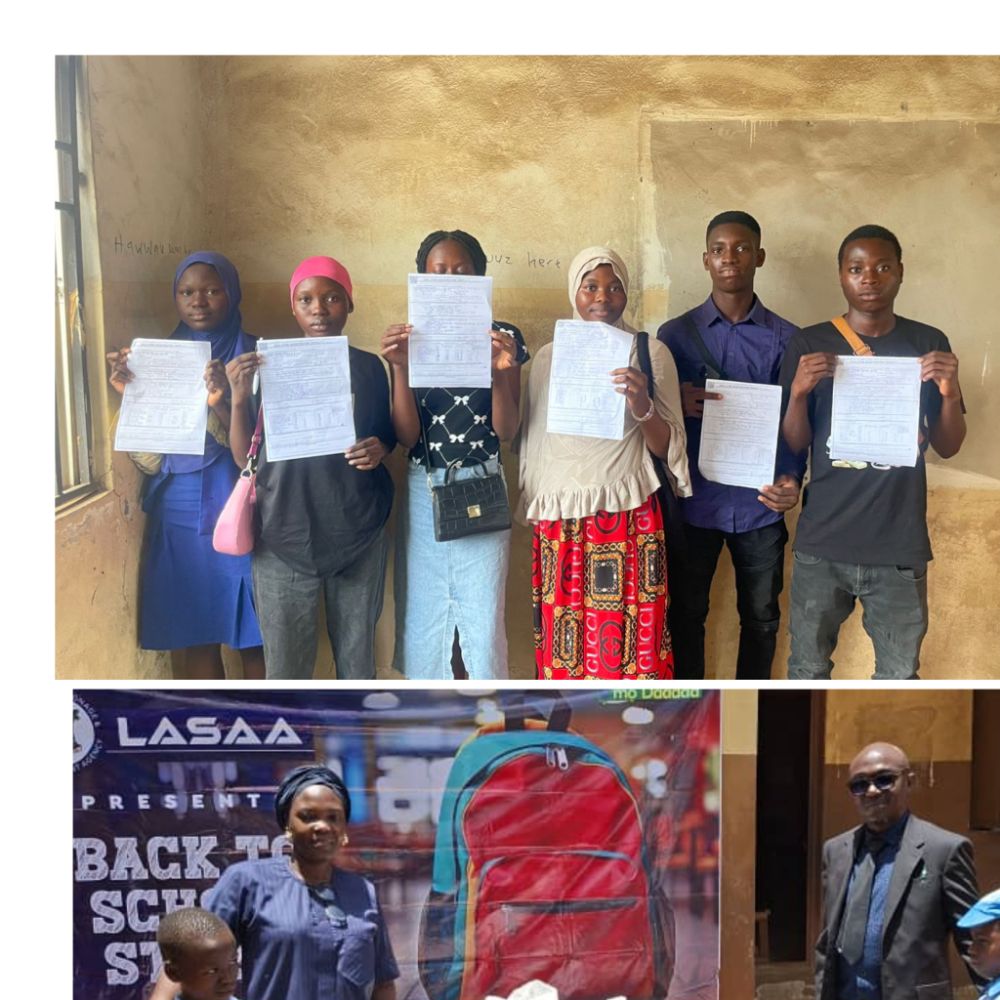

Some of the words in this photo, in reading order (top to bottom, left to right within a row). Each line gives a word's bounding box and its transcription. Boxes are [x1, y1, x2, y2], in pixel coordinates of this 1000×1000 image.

[586, 611, 598, 673] GUCCI
[639, 606, 654, 671] GUCCI
[117, 716, 303, 746] LASAA
[73, 836, 220, 880] BACK
